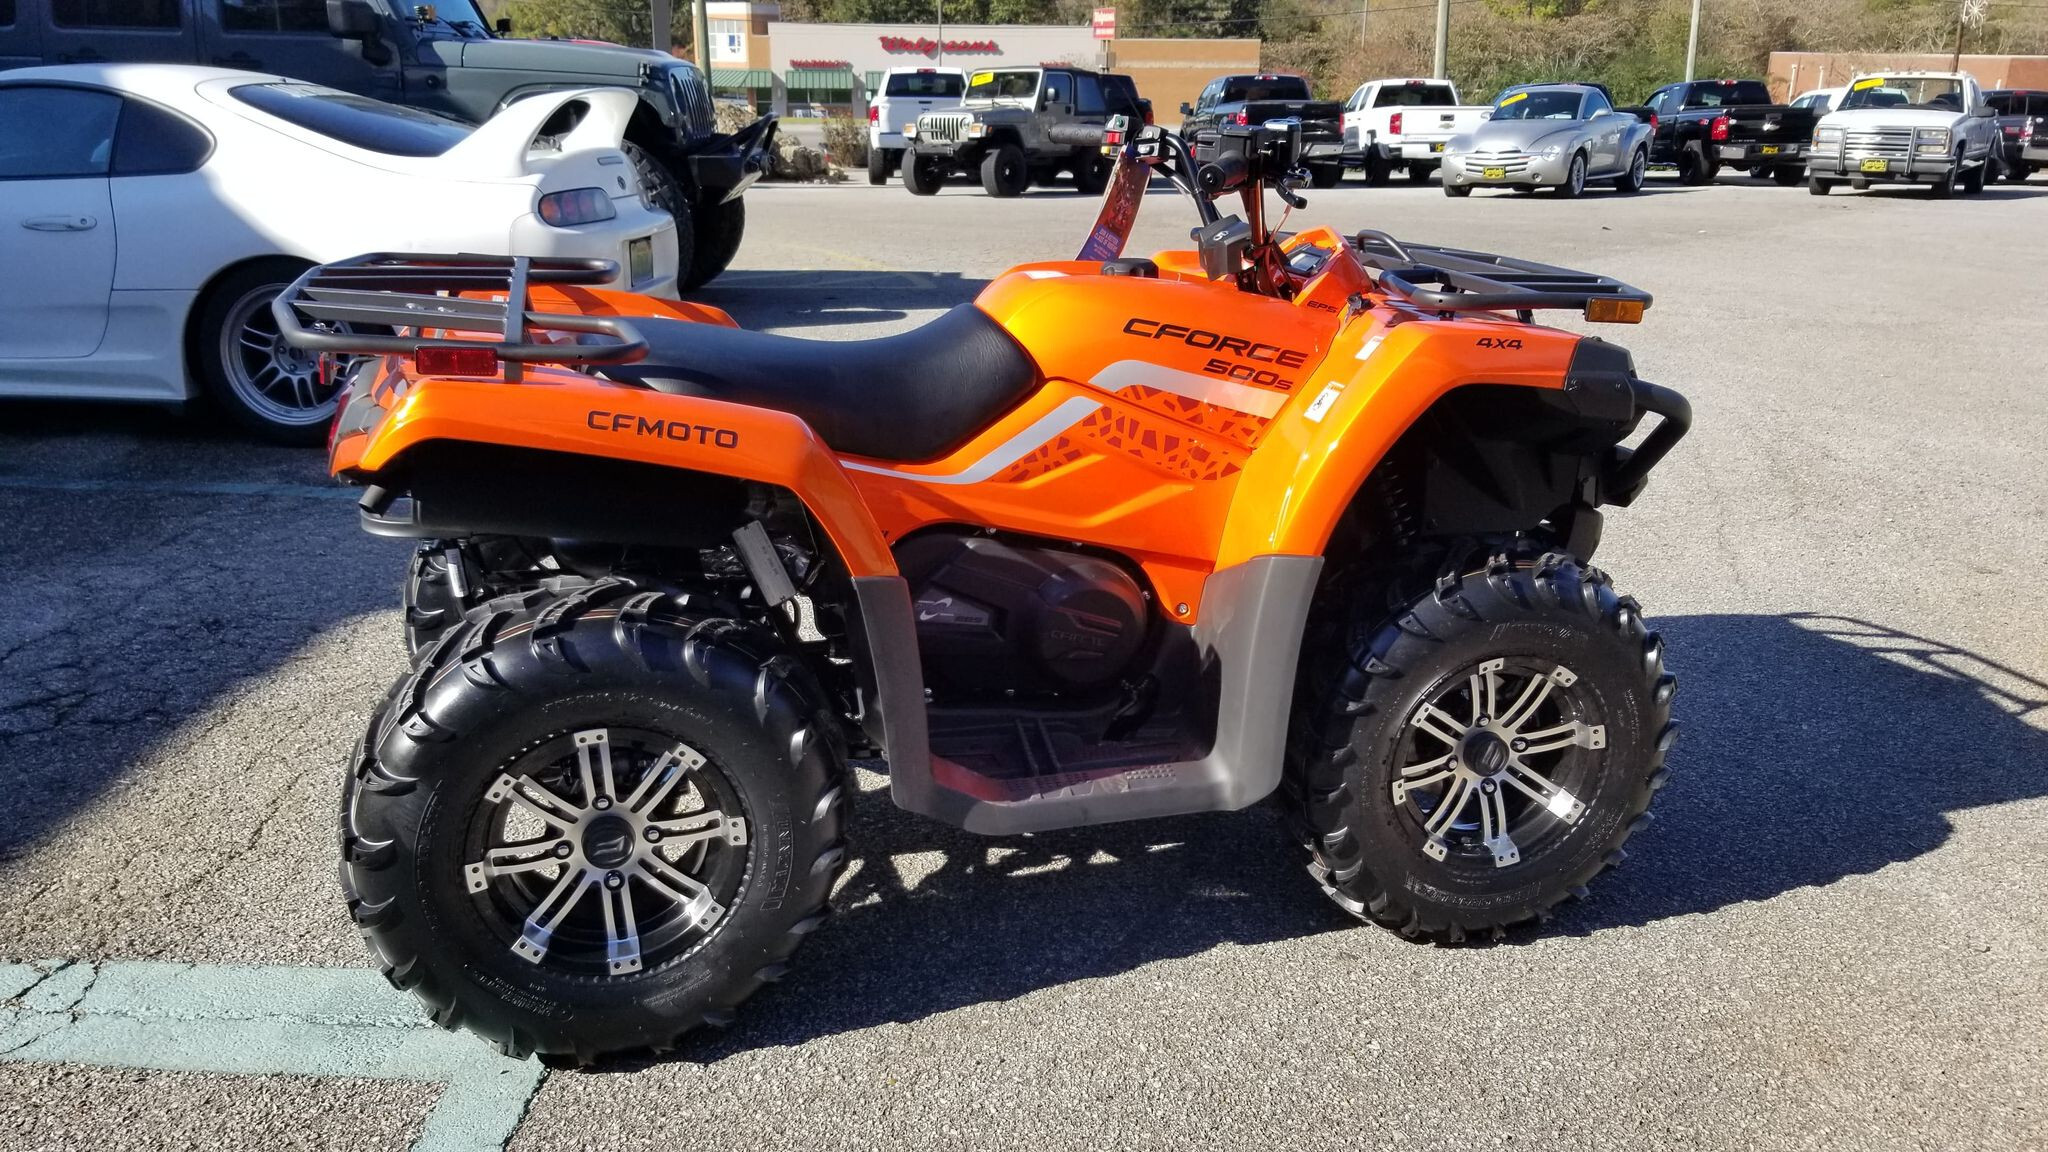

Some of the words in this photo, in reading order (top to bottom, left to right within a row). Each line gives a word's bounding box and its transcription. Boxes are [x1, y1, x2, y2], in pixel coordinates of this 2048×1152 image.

[1306, 300, 1338, 314] EPS
[1122, 317, 1309, 370] CFORCE
[587, 410, 739, 449] CFMOTO
